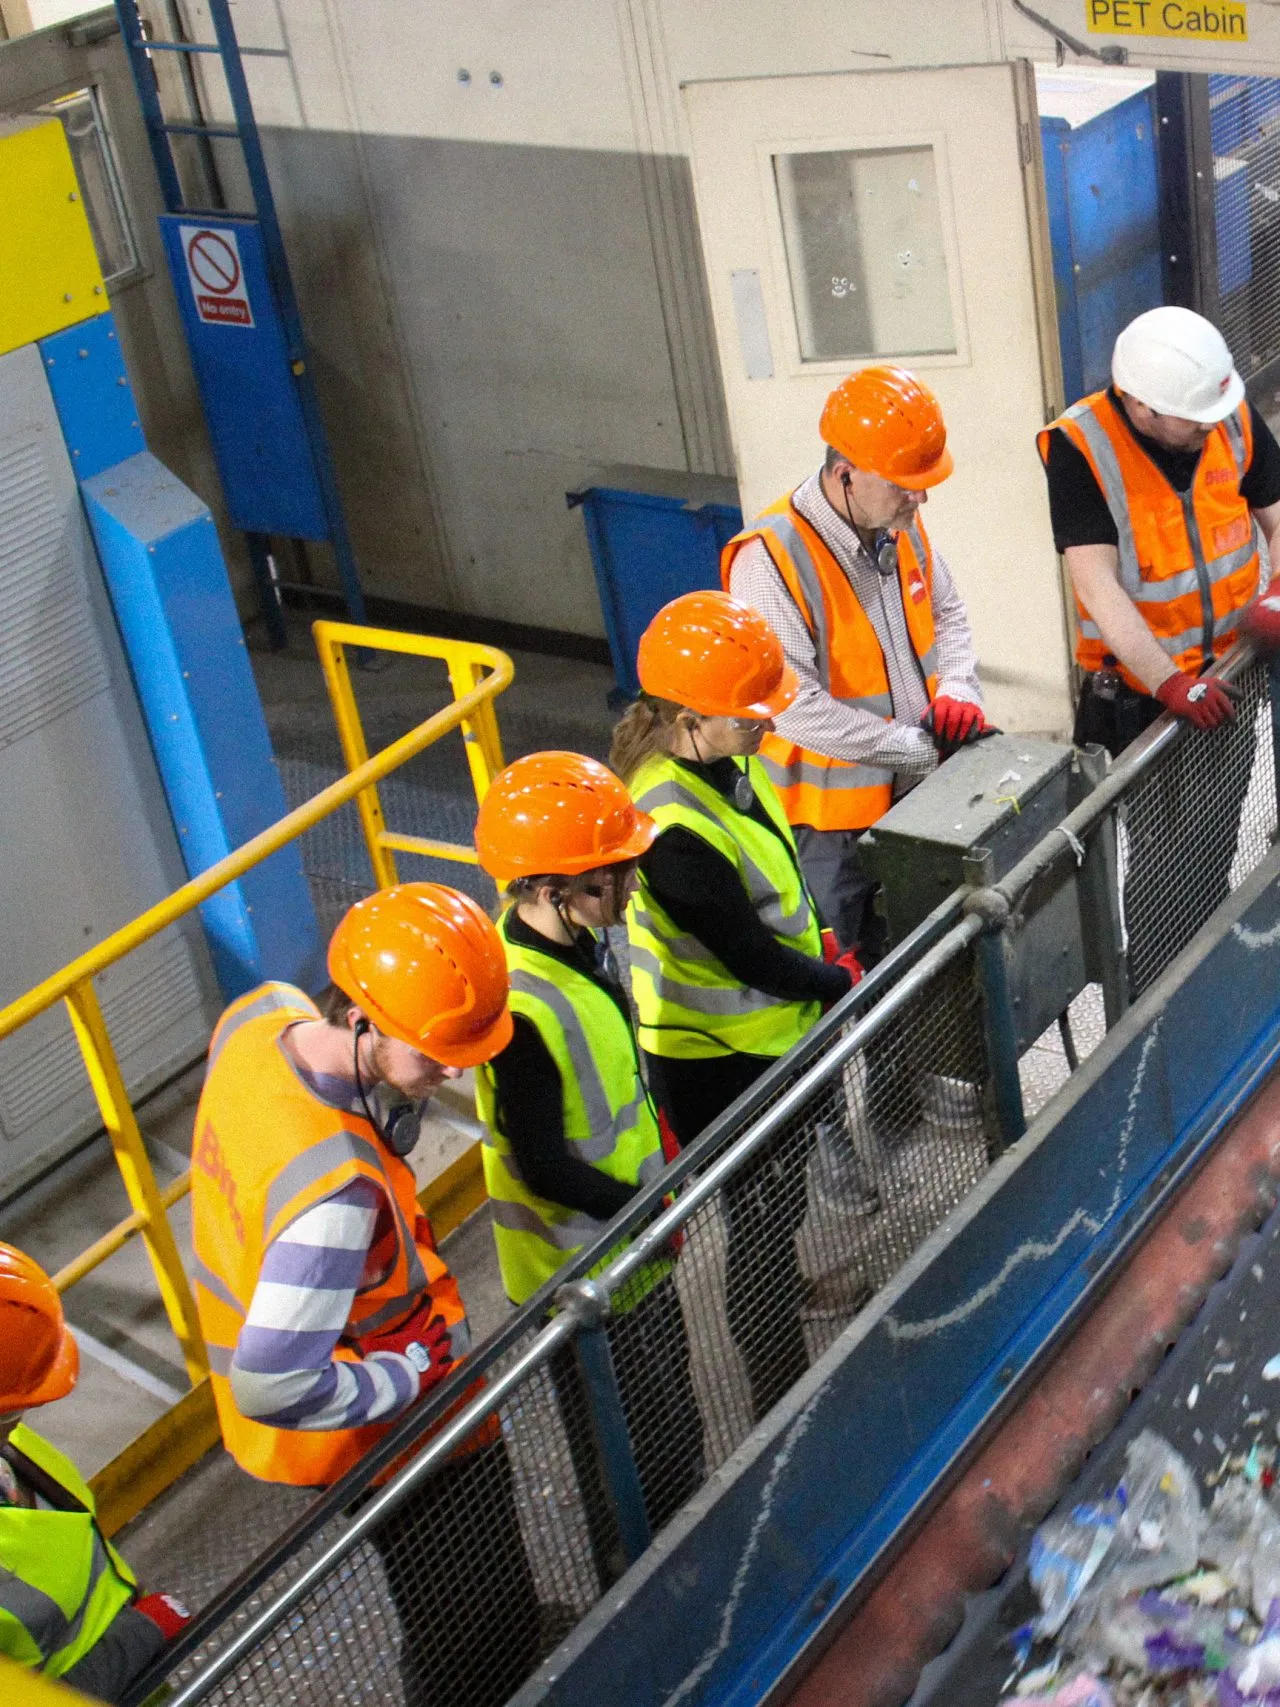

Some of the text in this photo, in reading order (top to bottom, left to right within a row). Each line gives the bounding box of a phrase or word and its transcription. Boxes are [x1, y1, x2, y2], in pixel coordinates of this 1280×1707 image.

[1091, 0, 1245, 34] PET Cabin
[201, 300, 246, 319] No entry
